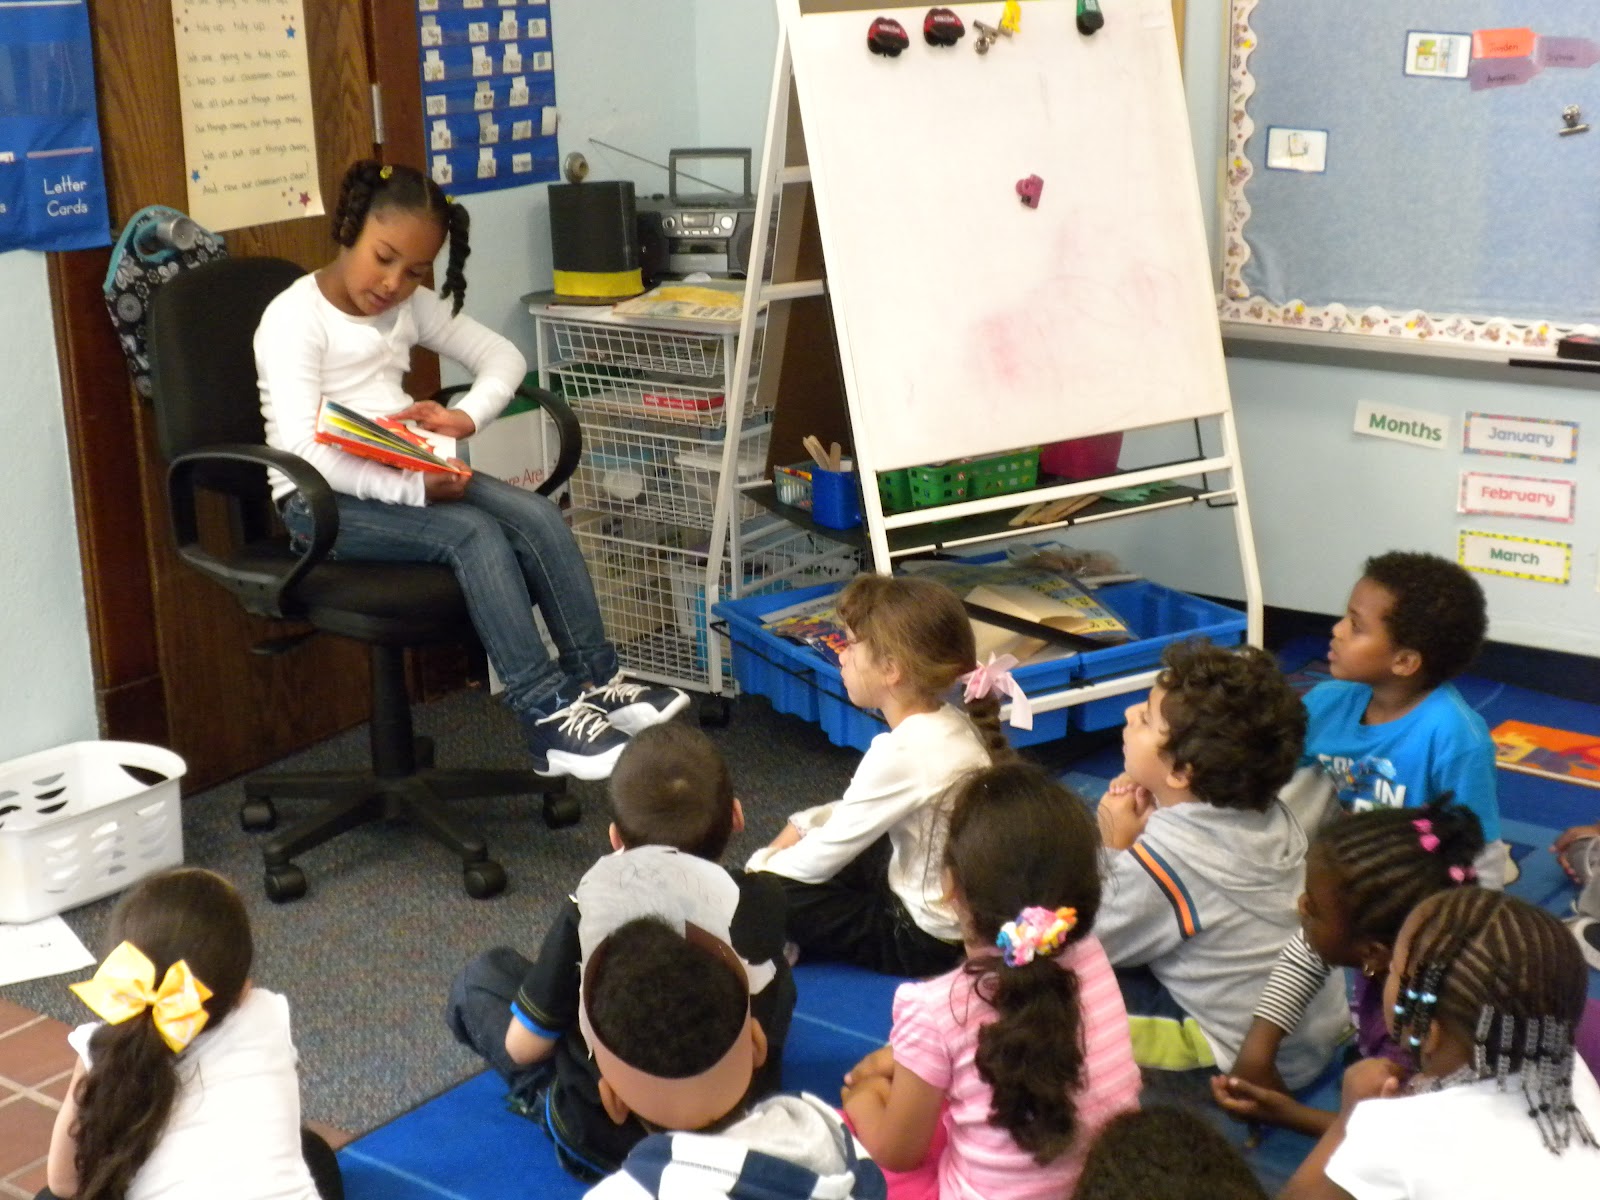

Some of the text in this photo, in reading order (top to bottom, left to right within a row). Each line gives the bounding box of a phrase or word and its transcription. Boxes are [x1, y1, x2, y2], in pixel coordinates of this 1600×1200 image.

[43, 175, 88, 195] Letter
[47, 197, 88, 217] Cards
[1369, 412, 1442, 442] Months
[1487, 426, 1555, 448] January
[1480, 485, 1556, 508] February
[1489, 546, 1541, 566] March
